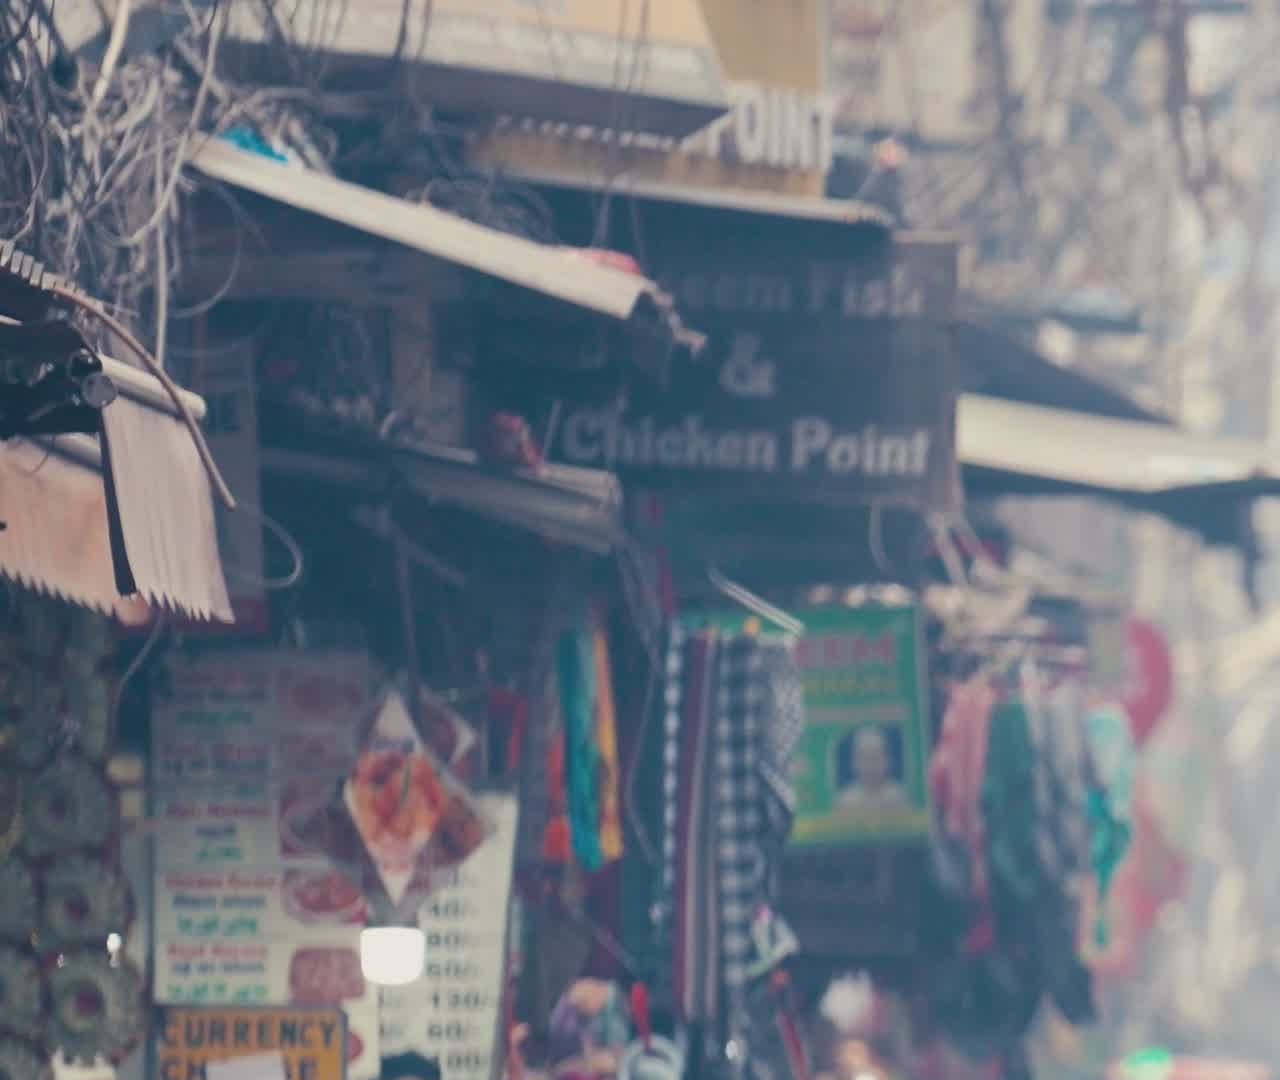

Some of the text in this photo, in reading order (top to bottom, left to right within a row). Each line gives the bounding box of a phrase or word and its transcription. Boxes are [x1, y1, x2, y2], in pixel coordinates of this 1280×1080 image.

[719, 332, 776, 397] &
[564, 406, 931, 477] Chicken Point
[161, 1017, 336, 1049] CURRENCY
